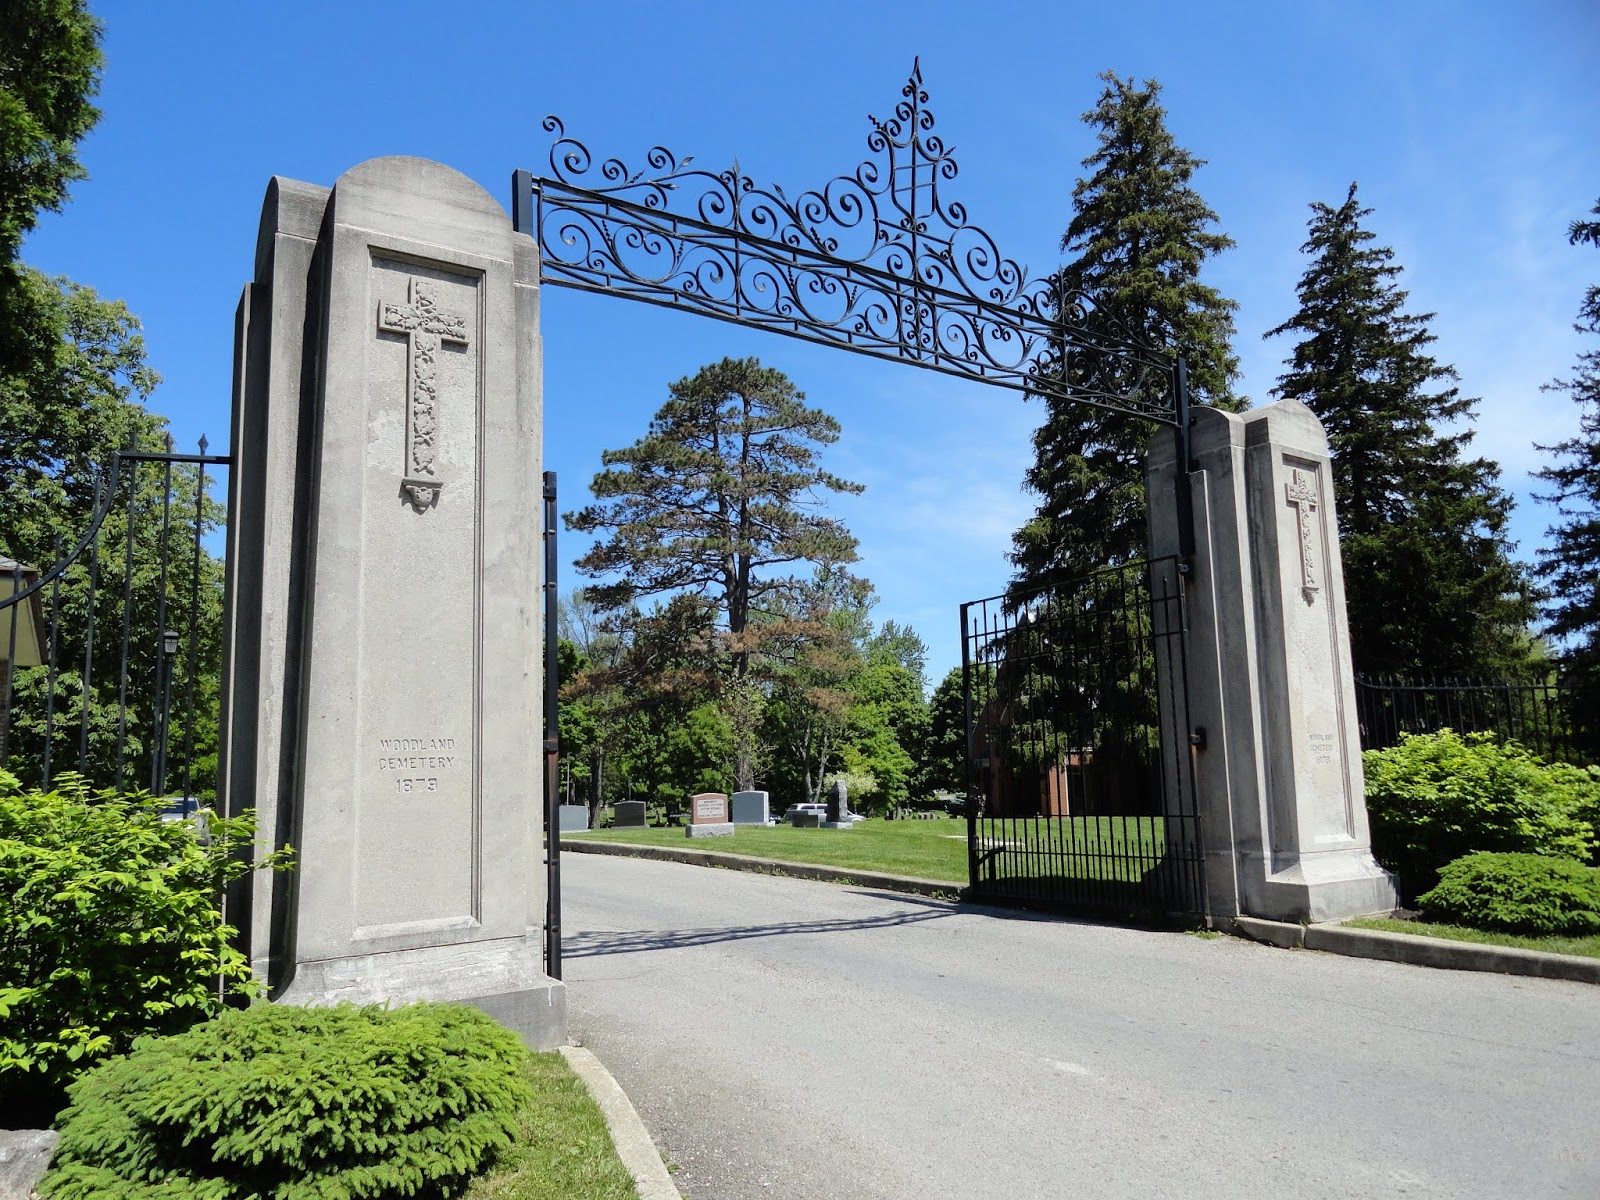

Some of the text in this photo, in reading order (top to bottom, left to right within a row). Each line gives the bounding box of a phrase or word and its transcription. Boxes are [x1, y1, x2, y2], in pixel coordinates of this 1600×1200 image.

[380, 738, 455, 751] WOODLAND
[379, 756, 455, 770] CEMETERY
[396, 778, 438, 793] 1879
